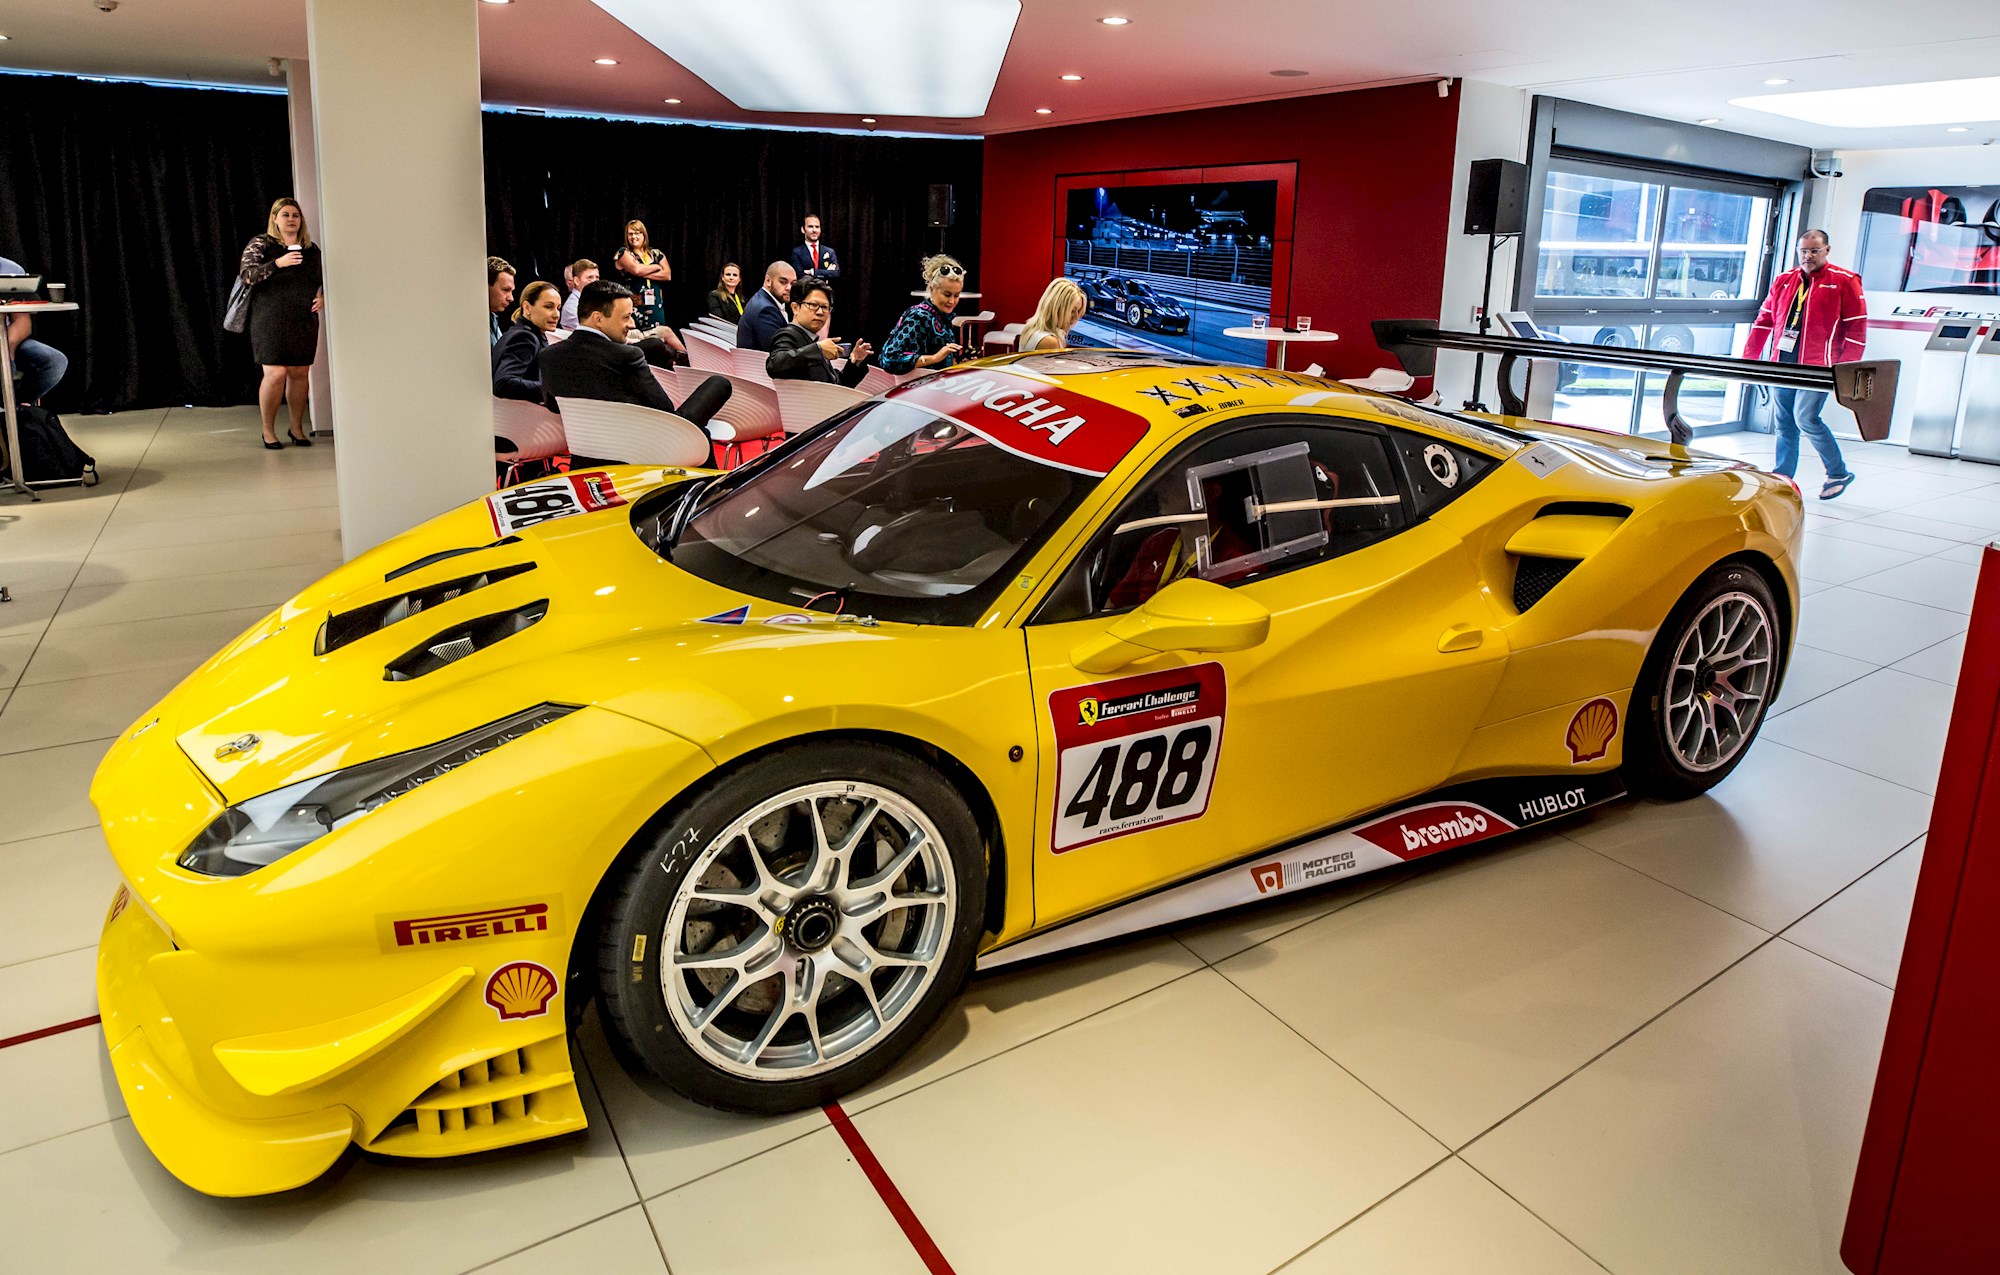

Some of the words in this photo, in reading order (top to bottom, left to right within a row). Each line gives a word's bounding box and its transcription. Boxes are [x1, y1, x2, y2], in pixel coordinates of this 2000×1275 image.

[928, 375, 1087, 447] SINGHA
[1101, 699, 1144, 717] Ferrari
[1144, 689, 1196, 708] Challenge
[1171, 704, 1197, 717] PIRELLI
[1063, 724, 1212, 829] 488
[1518, 788, 1586, 821] HUBLOT
[1099, 814, 1164, 835] races.ferrari.com
[1400, 811, 1488, 851] brembo
[1302, 851, 1354, 871] MOTEGI
[1304, 860, 1356, 880] RACING
[393, 903, 549, 947] PIRELLI
